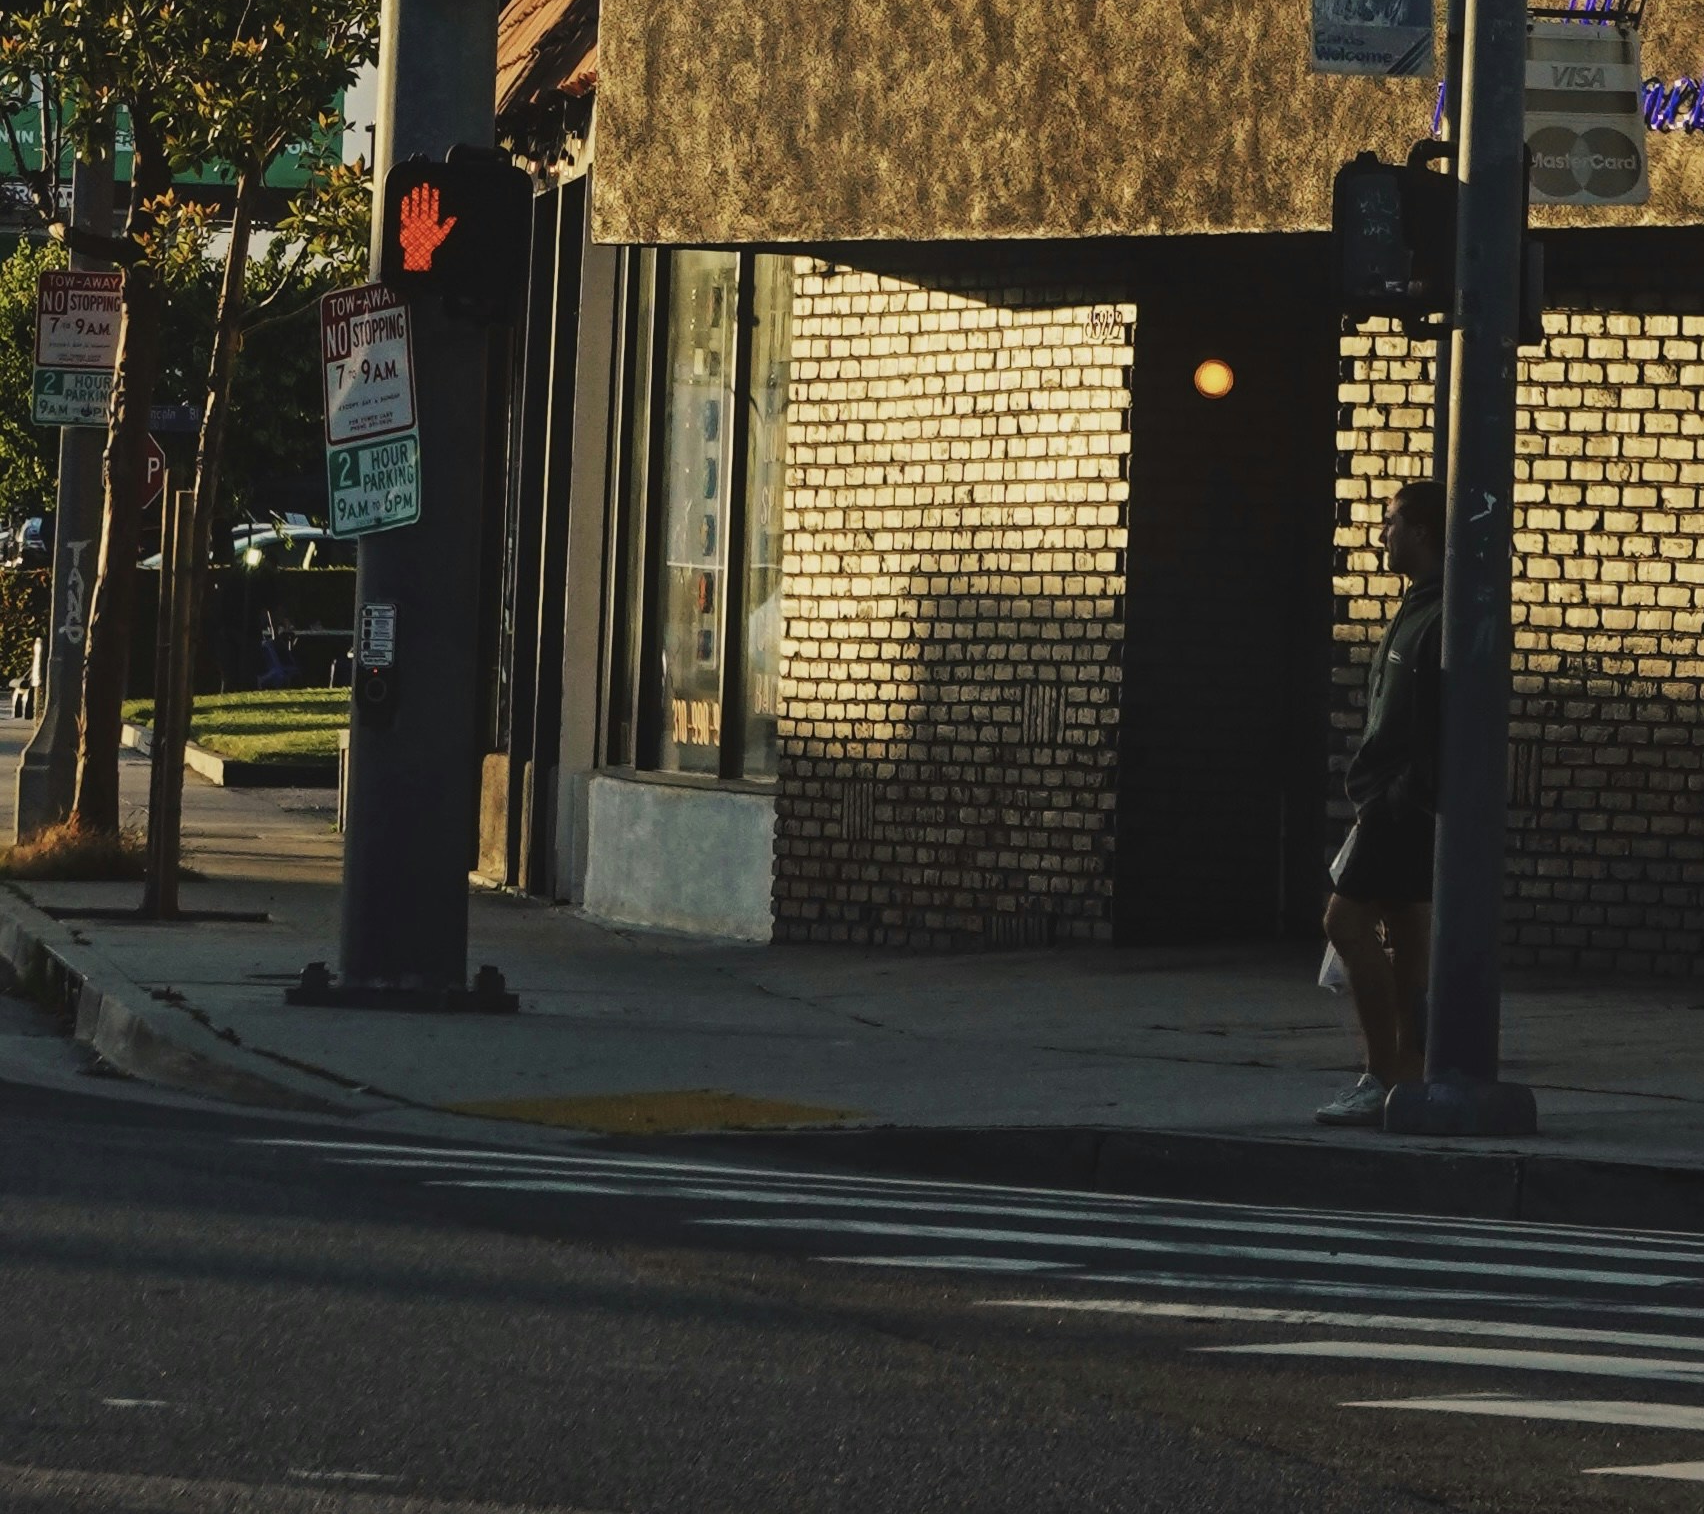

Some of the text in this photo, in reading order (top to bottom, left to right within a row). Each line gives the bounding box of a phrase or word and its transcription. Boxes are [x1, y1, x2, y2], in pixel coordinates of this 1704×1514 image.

[1315, 46, 1393, 64] Welcome
[1551, 66, 1606, 88] VISA
[48, 275, 120, 290] TOW-AWAY
[42, 290, 65, 312] NO
[70, 293, 120, 312] STOPPING
[50, 317, 60, 333] 7
[327, 313, 404, 358] NO STOPPING
[44, 371, 112, 394] 2 HOUR
[336, 364, 345, 389] 7
[66, 388, 112, 402] PARKIN
[150, 409, 176, 420] ncoln
[338, 444, 409, 489] 2 HOUR
[363, 465, 415, 493] PARKING
